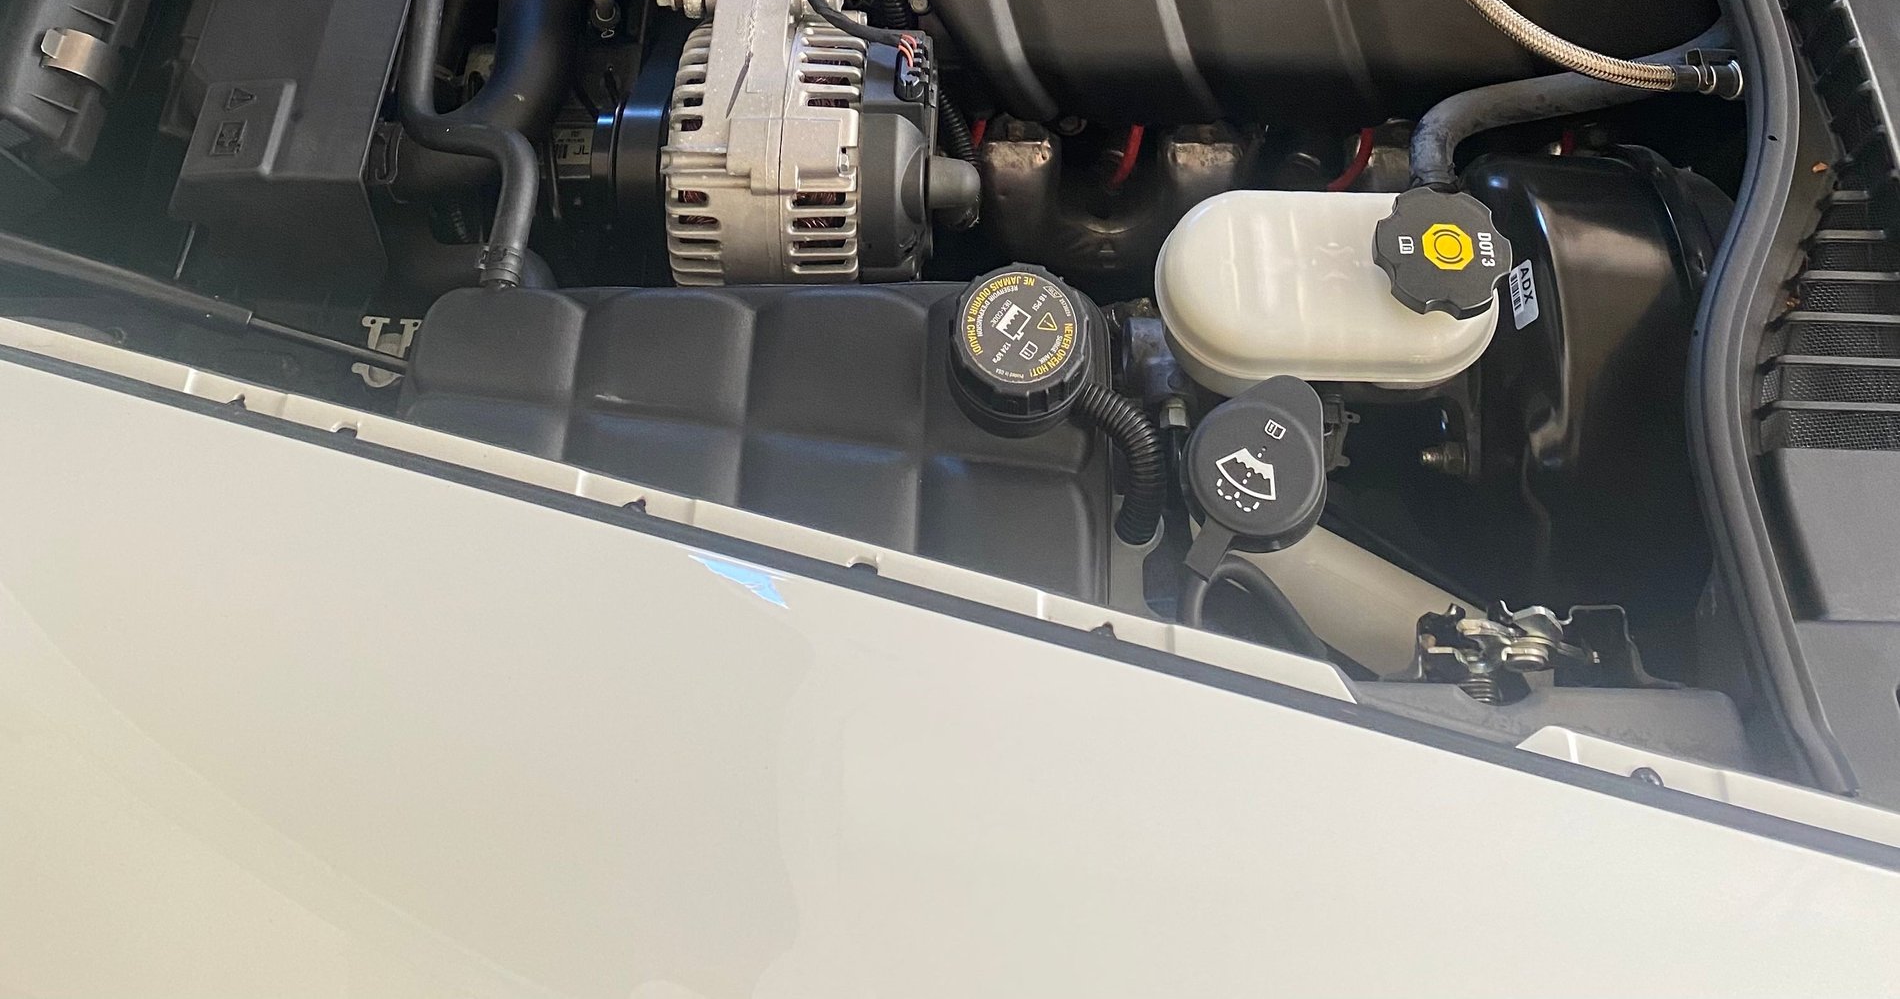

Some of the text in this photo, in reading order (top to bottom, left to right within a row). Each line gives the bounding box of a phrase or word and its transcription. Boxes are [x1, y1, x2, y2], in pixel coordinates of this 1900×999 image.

[1477, 232, 1496, 267] DOT 3
[990, 275, 1022, 292] JAMAIS
[1023, 276, 1036, 287] NE
[1520, 267, 1534, 305] ADX
[969, 287, 991, 314] OUVRIR
[1031, 299, 1042, 312] PSI
[966, 324, 984, 356] CHAUD!
[1062, 322, 1074, 350] NEVER
[992, 342, 1012, 364] 124 kPa
[1038, 335, 1063, 364] SURGE TANK
[1048, 349, 1067, 368] OPEN
[1029, 362, 1050, 378] HOT!
